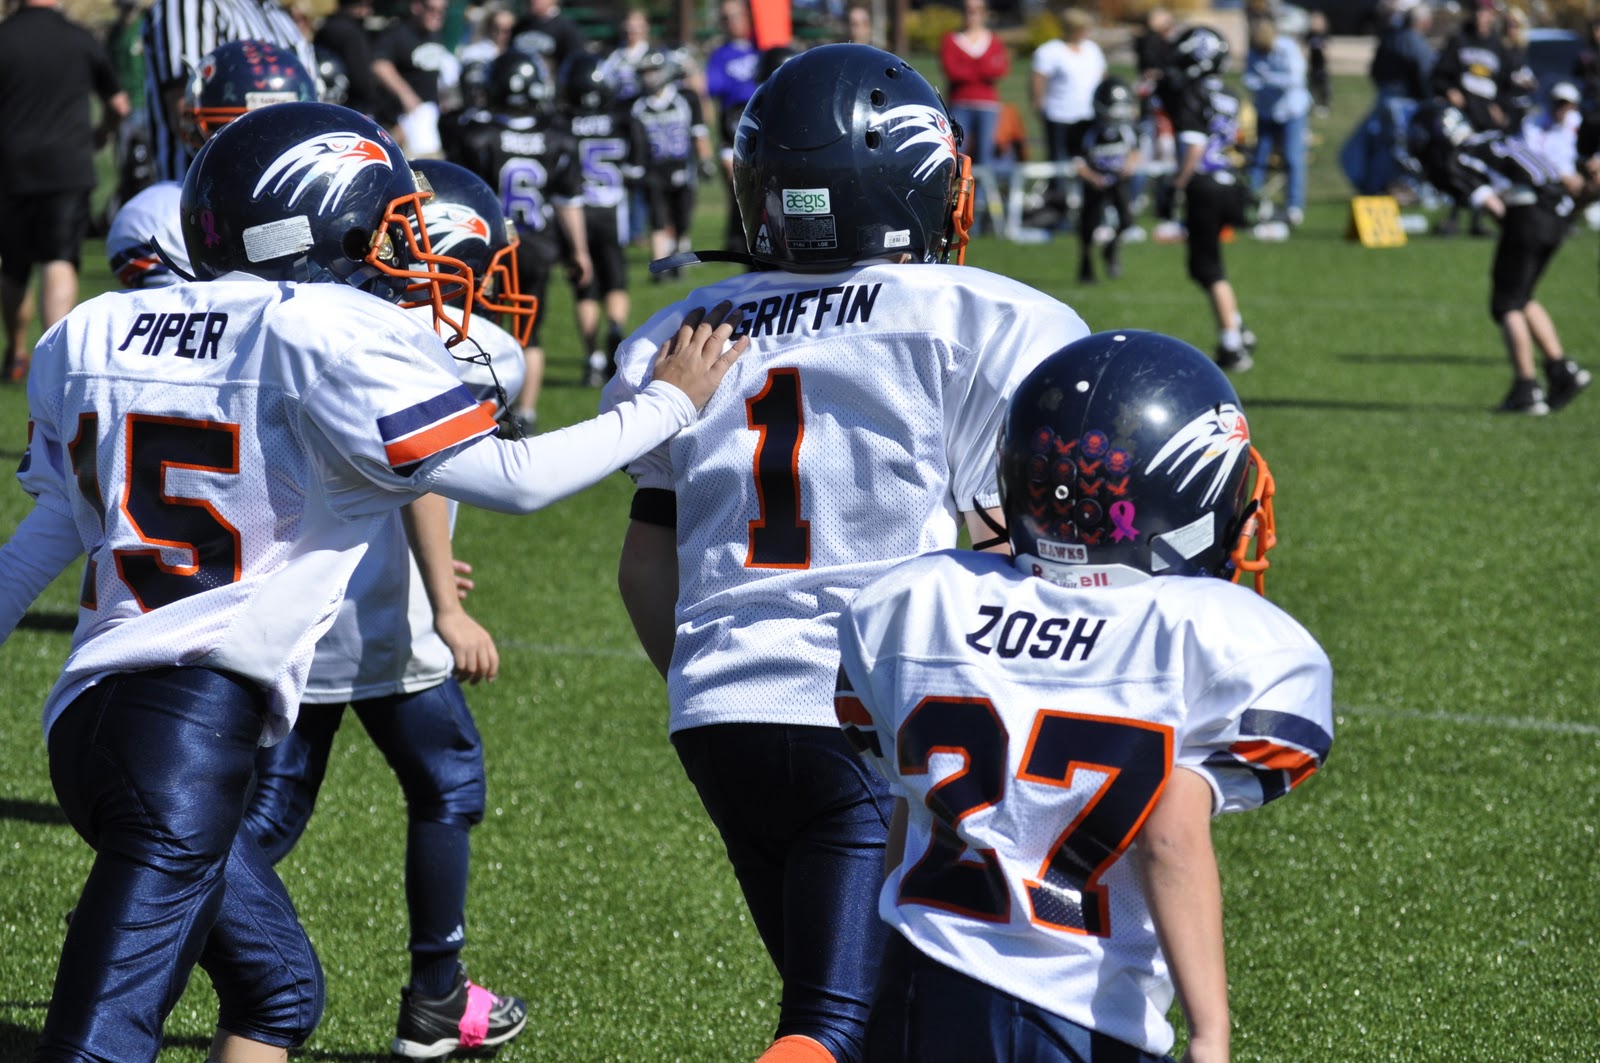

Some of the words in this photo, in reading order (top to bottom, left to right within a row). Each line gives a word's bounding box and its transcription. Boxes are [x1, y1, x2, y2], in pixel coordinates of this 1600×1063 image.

[499, 157, 548, 231] 6
[578, 138, 627, 206] 5
[117, 311, 229, 360] PIPER
[729, 282, 883, 342] GRIFFIN
[743, 366, 811, 570] 1
[67, 411, 242, 614] 15
[1039, 542, 1086, 561] HAWKS
[965, 604, 1108, 661] ZOSH
[896, 695, 1175, 938] 27
